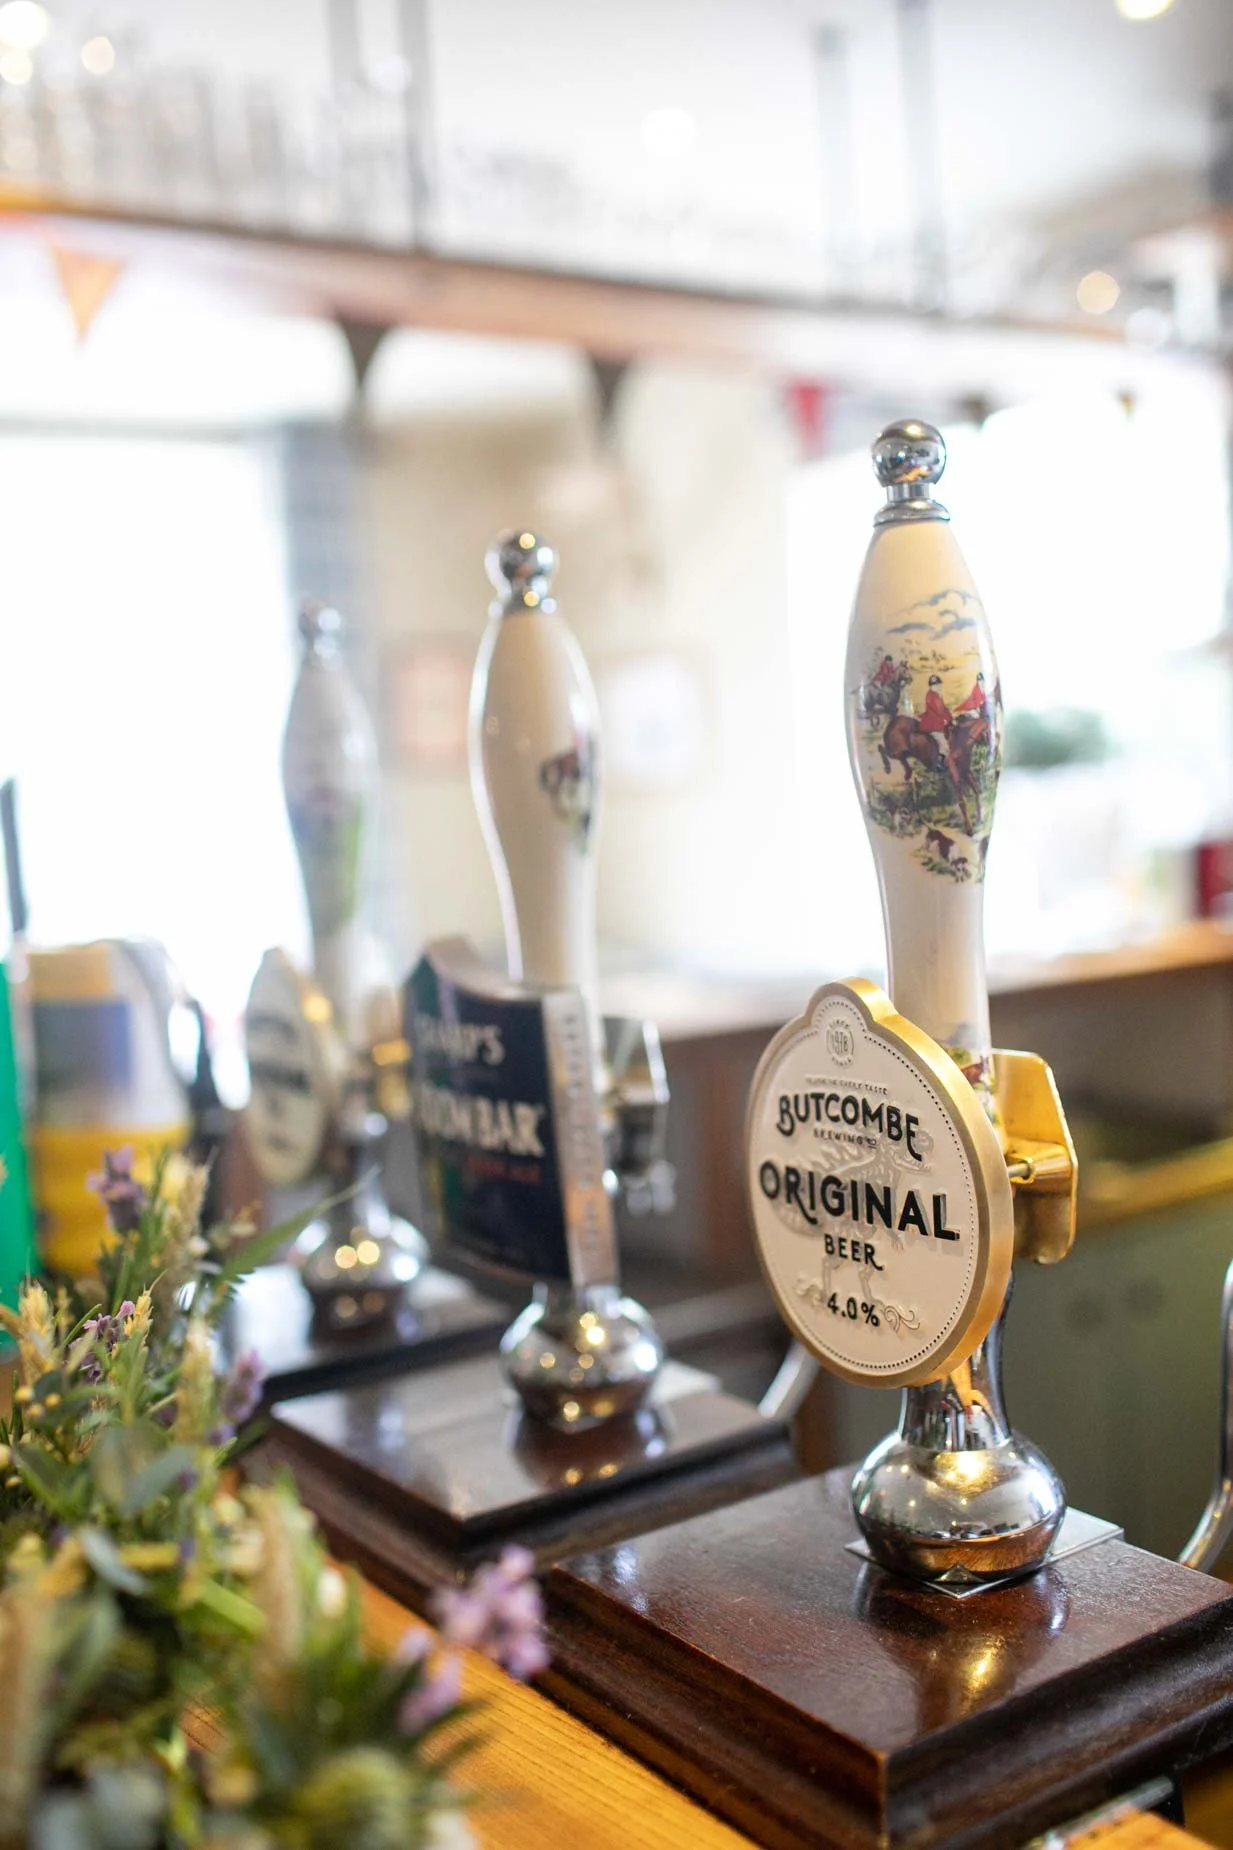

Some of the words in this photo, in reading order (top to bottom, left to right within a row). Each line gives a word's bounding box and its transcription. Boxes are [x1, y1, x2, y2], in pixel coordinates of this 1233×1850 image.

[864, 1083, 888, 1096] TASTE
[476, 1097, 543, 1157] BAR
[777, 1093, 923, 1161] BUTCOMBE
[814, 1128, 863, 1145] BREWING
[758, 1160, 961, 1242] ORIGINAL
[824, 1233, 884, 1271] BEER
[827, 1291, 881, 1328] 4.0%
